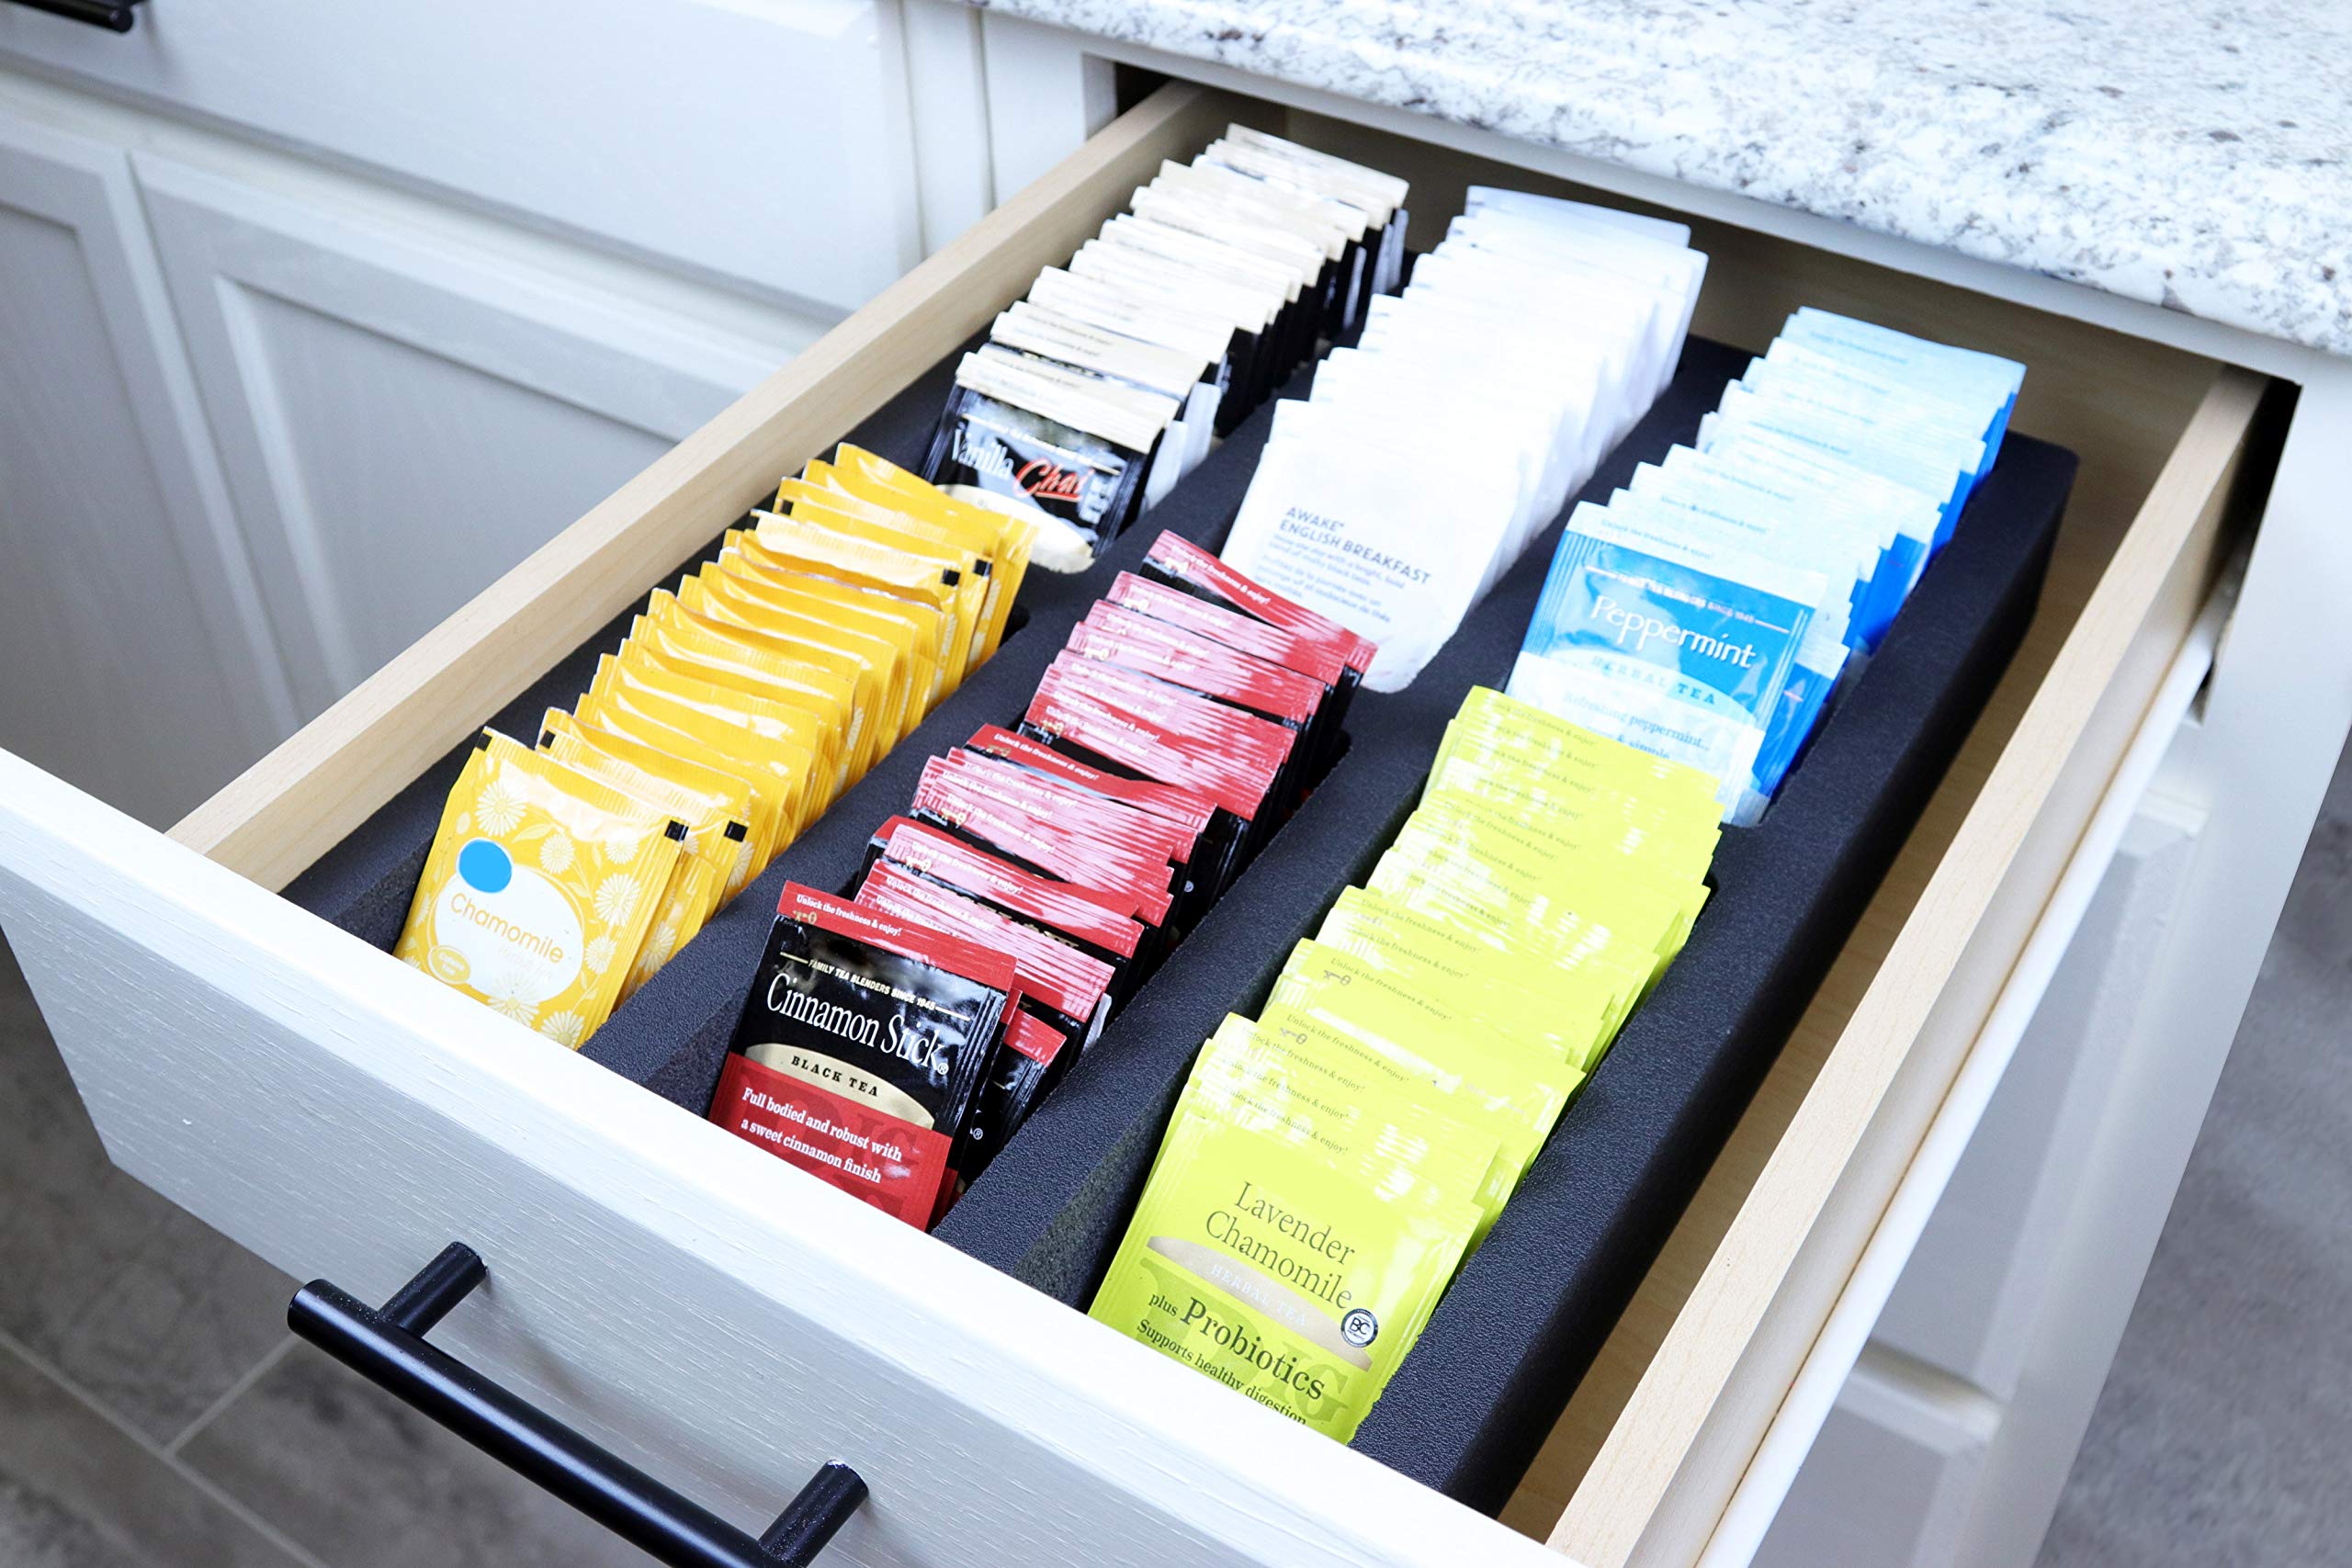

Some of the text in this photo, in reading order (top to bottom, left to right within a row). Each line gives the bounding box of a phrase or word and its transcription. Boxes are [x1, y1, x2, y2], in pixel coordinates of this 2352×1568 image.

[1014, 457, 1095, 501] Chai
[1280, 520, 1340, 547] ENGLISH
[1343, 540, 1430, 584] BREAKFAST
[1239, 583, 1248, 592] &
[1590, 594, 1757, 668] Peppermint
[1677, 682, 1715, 705] TEA
[1091, 705, 1129, 728] freshness
[1127, 722, 1136, 732] &
[1134, 725, 1160, 743] enjoy!
[994, 732, 1021, 749] Unlock
[1020, 742, 1033, 752] the
[1032, 747, 1068, 766] freshness
[1072, 766, 1099, 782] enjoy!
[1565, 750, 1573, 760] &
[1561, 774, 1568, 784] &
[1020, 799, 1028, 809] &
[985, 813, 1024, 838] freshness
[1023, 832, 1031, 841] &
[1027, 835, 1056, 854] enjoy!
[1525, 840, 1532, 848] &
[1547, 831, 1555, 840] &
[989, 874, 997, 883] &
[994, 877, 1023, 897] enjoy!
[1506, 860, 1515, 870] &
[450, 892, 564, 964] Chamomile
[796, 894, 901, 938] Unlock the freshness & enjoy!
[1477, 908, 1486, 916] &
[1390, 942, 1432, 964] freshness
[1432, 959, 1440, 968] &
[1445, 932, 1453, 941] &
[808, 959, 937, 1011] FAMILY TEA BLENDERS SINCE 1945
[1330, 956, 1360, 976] Unlock
[1361, 971, 1375, 982] the
[1375, 978, 1417, 1002] freshness
[767, 972, 879, 1047] Cinnamon
[1286, 1013, 1317, 1033] Unlock
[1317, 1028, 1332, 1041] the
[1331, 1036, 1374, 1063] freshness
[1373, 1058, 1381, 1066] &
[791, 1055, 878, 1097] BLACK TEA
[1286, 1049, 1329, 1075] freshness
[1328, 1069, 1337, 1077] &
[1311, 1098, 1319, 1106] &
[742, 1087, 902, 1162] Full bodied and robust with
[1311, 1130, 1319, 1139] &
[741, 1119, 882, 1183] a sweet cinnamon finish
[1234, 1181, 1355, 1265] Lavender
[1205, 1210, 1353, 1309] Chamomile
[1211, 1265, 1306, 1327] HERBAL TEA
[1350, 1316, 1371, 1335] BC
[1148, 1293, 1325, 1400] plus Probiotics
[1136, 1318, 1306, 1425] Supports healthy digestion
